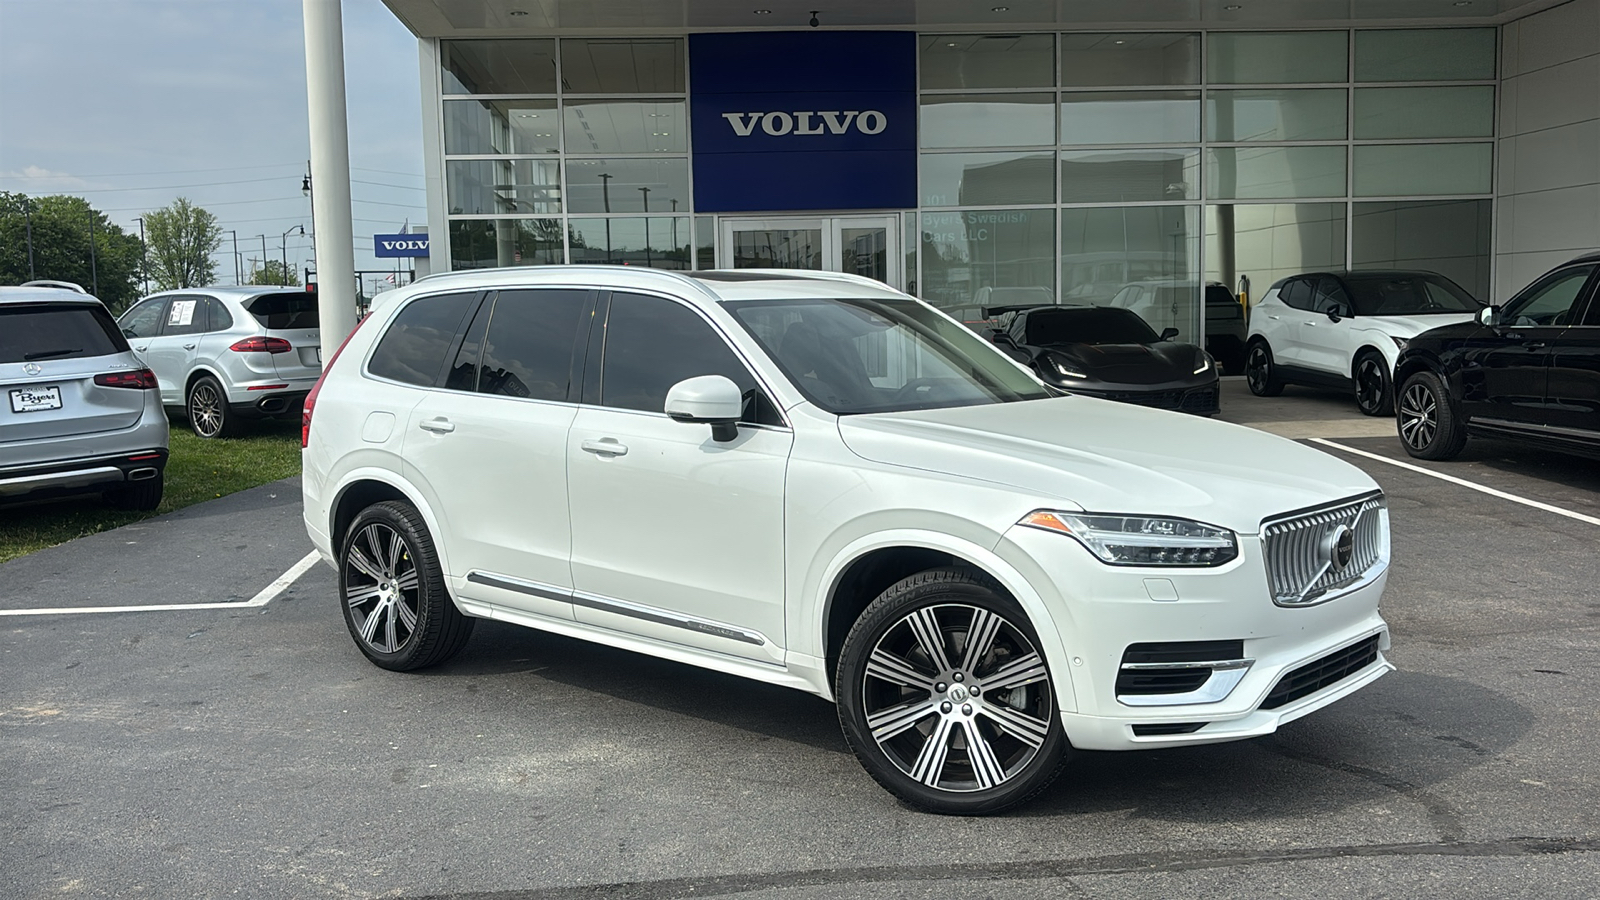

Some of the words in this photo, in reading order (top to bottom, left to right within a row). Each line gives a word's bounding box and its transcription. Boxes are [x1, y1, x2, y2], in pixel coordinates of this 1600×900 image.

[721, 110, 888, 137] VOLVO
[923, 214, 962, 228] Byers
[967, 212, 1027, 224] Swedish
[922, 230, 955, 243] Cars
[960, 228, 988, 242] LLC
[381, 240, 429, 250] VOLV
[15, 392, 56, 403] Byers
